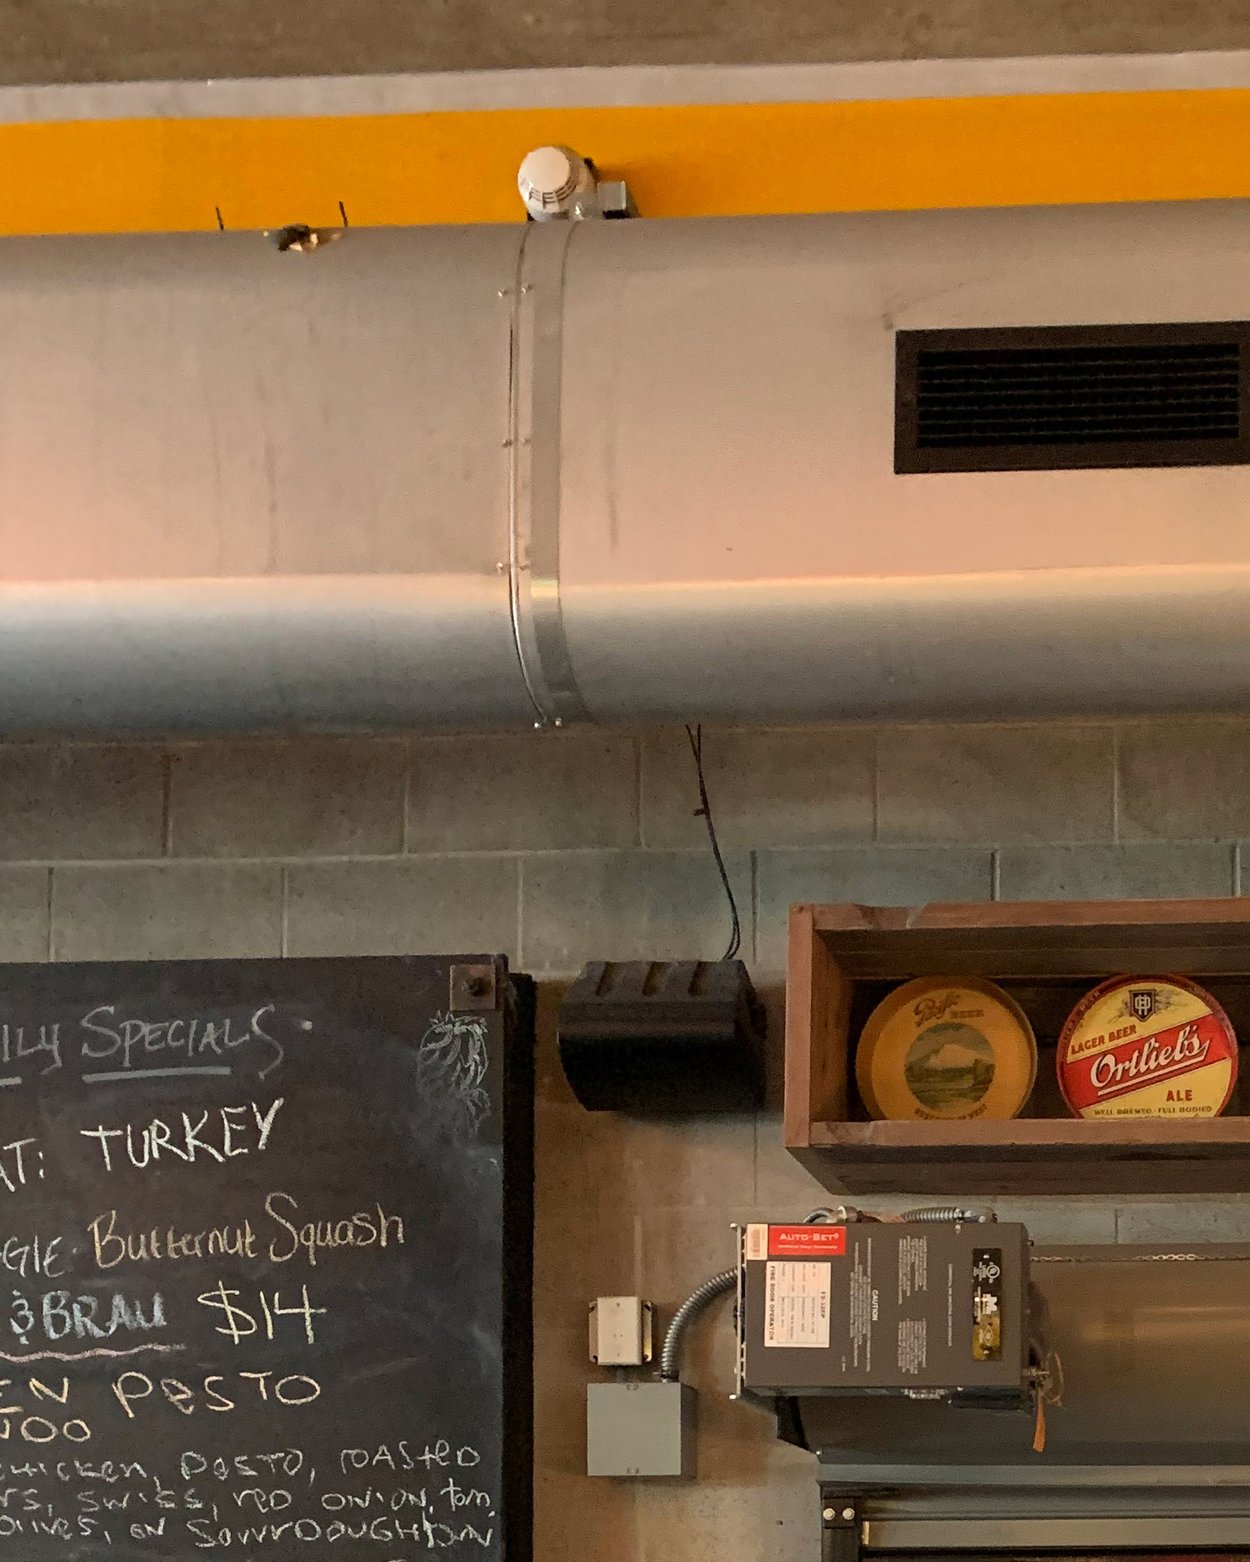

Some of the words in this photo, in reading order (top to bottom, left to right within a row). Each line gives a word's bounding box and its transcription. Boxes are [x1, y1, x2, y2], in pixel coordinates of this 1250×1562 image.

[80, 1003, 285, 1081] SPECIALS
[1070, 1035, 1106, 1056] LAGER
[1108, 1024, 1137, 1042] BEER
[1090, 1023, 1208, 1089] Ortlieb's
[1094, 1108, 1113, 1116] WELL
[1157, 1106, 1176, 1114] FULL
[1179, 1105, 1213, 1114] BODIED
[1165, 1090, 1194, 1103] ALE
[80, 1097, 285, 1172] TURKEY
[87, 1210, 258, 1270] Butternut
[264, 1191, 405, 1267] Squash
[197, 1280, 327, 1346] $14
[0, 1457, 162, 1492] HICKeN,
